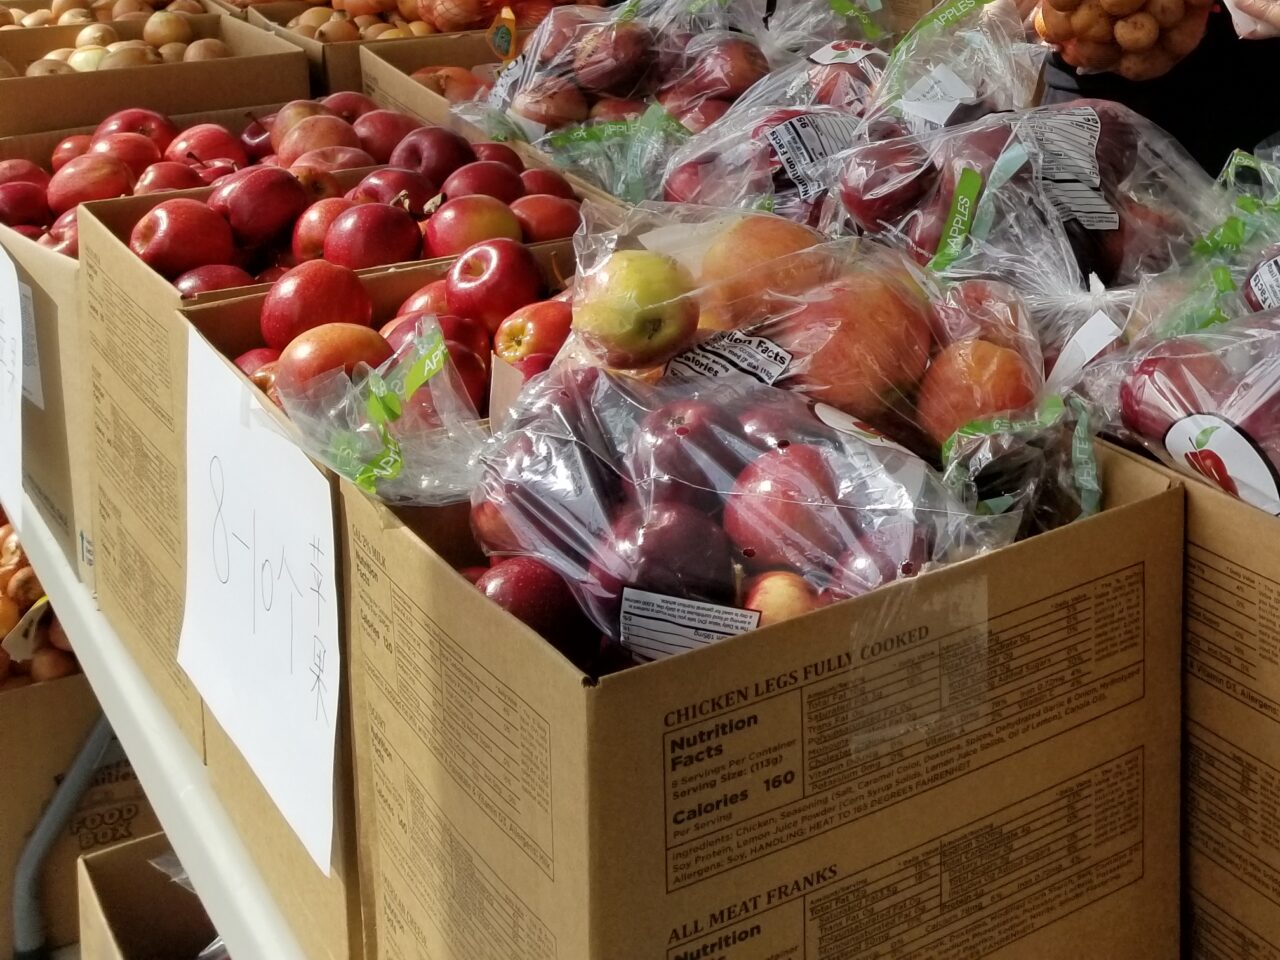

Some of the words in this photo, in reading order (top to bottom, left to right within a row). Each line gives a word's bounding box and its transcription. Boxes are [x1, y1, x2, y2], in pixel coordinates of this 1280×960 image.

[769, 129, 788, 156] Facts
[946, 195, 971, 250] APPLES
[684, 354, 720, 377] alories
[755, 339, 787, 366] Facts
[665, 684, 748, 729] CHICKEN
[753, 668, 798, 698] LEGS
[802, 649, 852, 682] FULLY
[860, 622, 928, 662] COOKED
[1240, 687, 1277, 717] Allergens:
[670, 709, 758, 755] Nutrition
[671, 739, 723, 773] Facts
[672, 776, 716, 803] Serving
[720, 766, 746, 784] Size:
[750, 752, 782, 774] (113g)
[681, 761, 726, 787] Servings
[728, 755, 745, 769] Per
[748, 736, 796, 762] Container
[672, 784, 748, 828] Calories
[763, 767, 795, 793] 160
[809, 815, 834, 833] HEAT
[838, 808, 850, 821] TO
[870, 783, 913, 808] DEGREES
[915, 760, 970, 789] FAHRENHEIT
[79, 821, 132, 851] BOX
[673, 825, 689, 839] Per
[693, 809, 732, 834] Serving
[668, 916, 703, 945] ALL
[709, 893, 760, 929] MEAT
[766, 862, 837, 906] FRANKS
